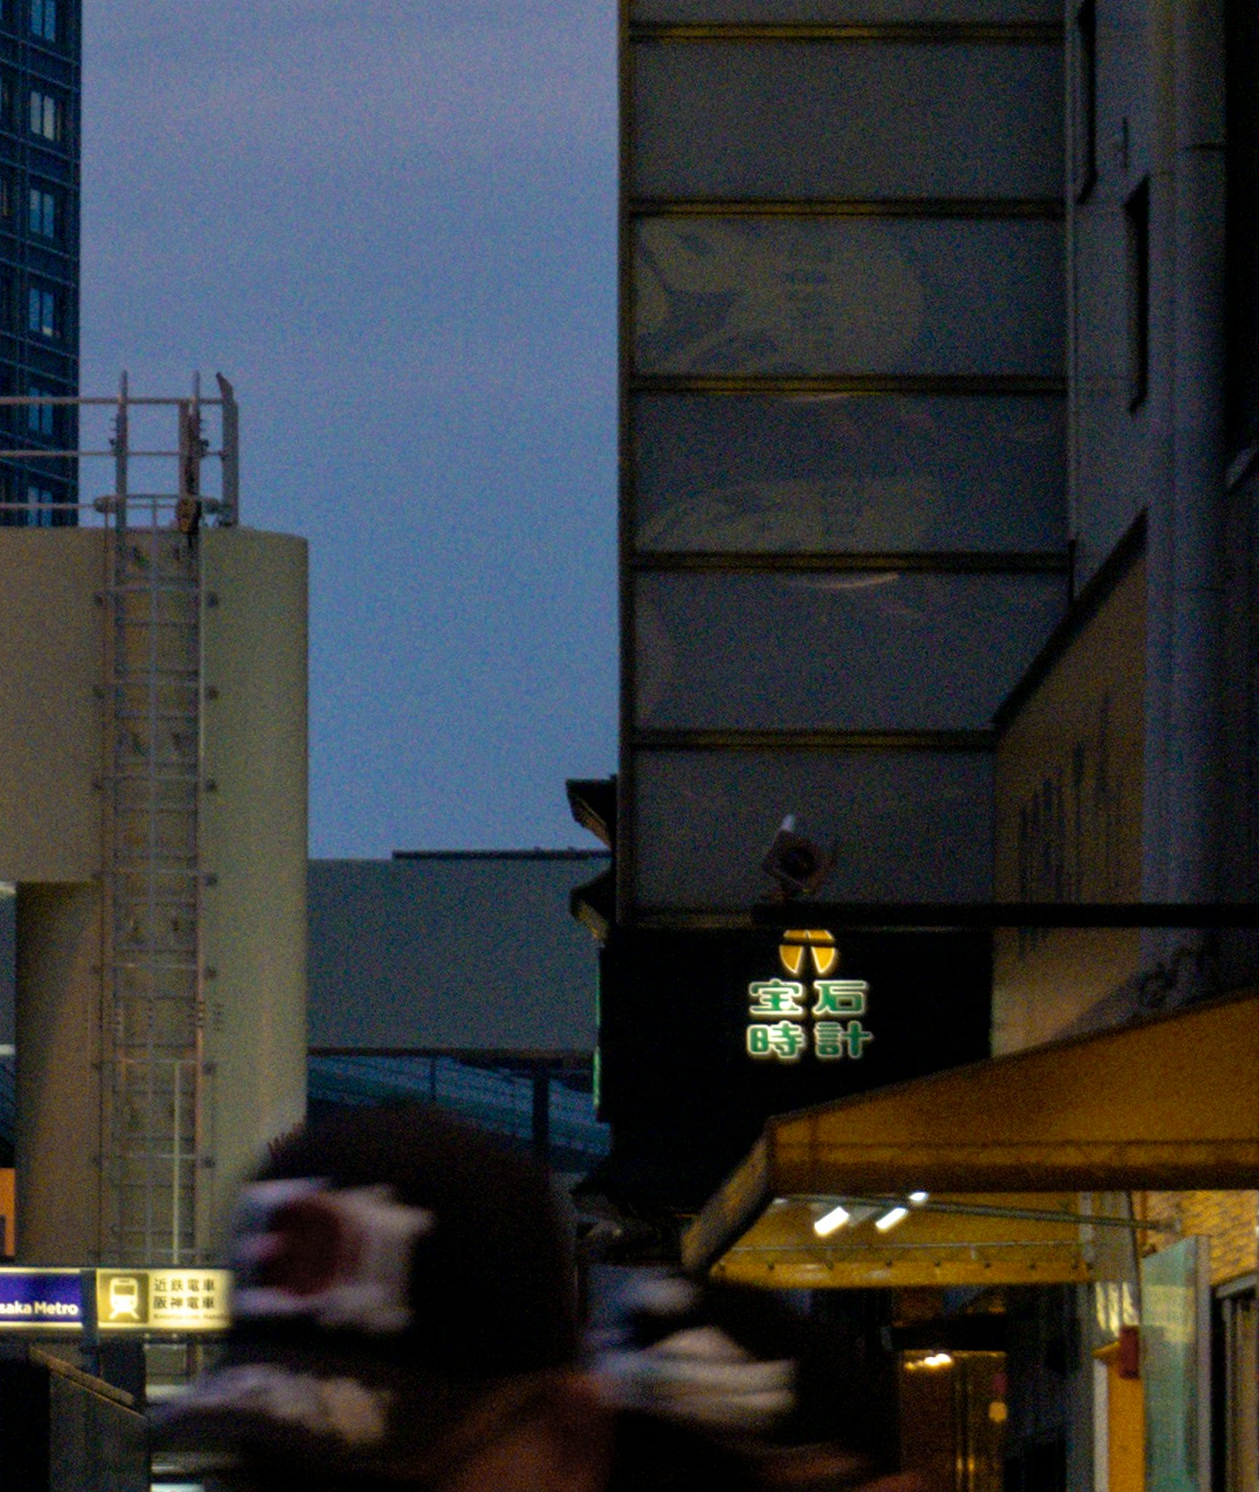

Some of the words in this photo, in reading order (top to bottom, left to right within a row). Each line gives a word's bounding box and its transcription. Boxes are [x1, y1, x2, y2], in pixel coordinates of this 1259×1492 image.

[749, 978, 869, 1015] 宝石
[746, 1020, 873, 1059] 時計
[34, 1300, 80, 1316] Metro
